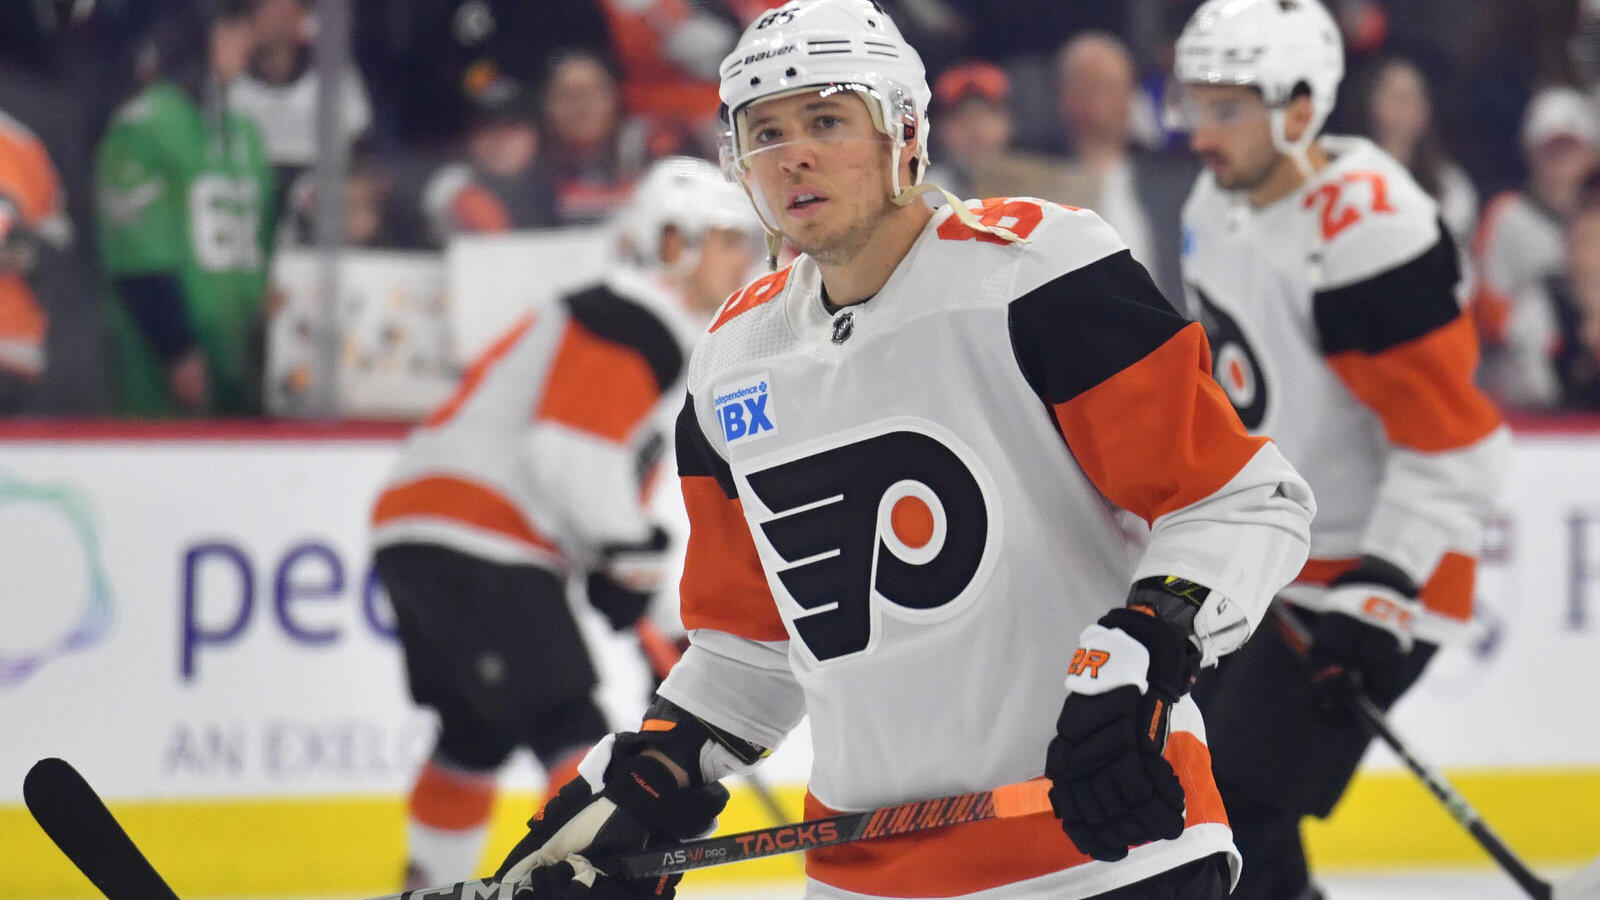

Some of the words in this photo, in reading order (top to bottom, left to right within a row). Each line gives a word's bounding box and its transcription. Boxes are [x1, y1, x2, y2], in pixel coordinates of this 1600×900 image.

[1304, 169, 1395, 242] 27
[168, 722, 244, 774] AN
[705, 847, 727, 860] PRO
[735, 821, 839, 856] TACKS
